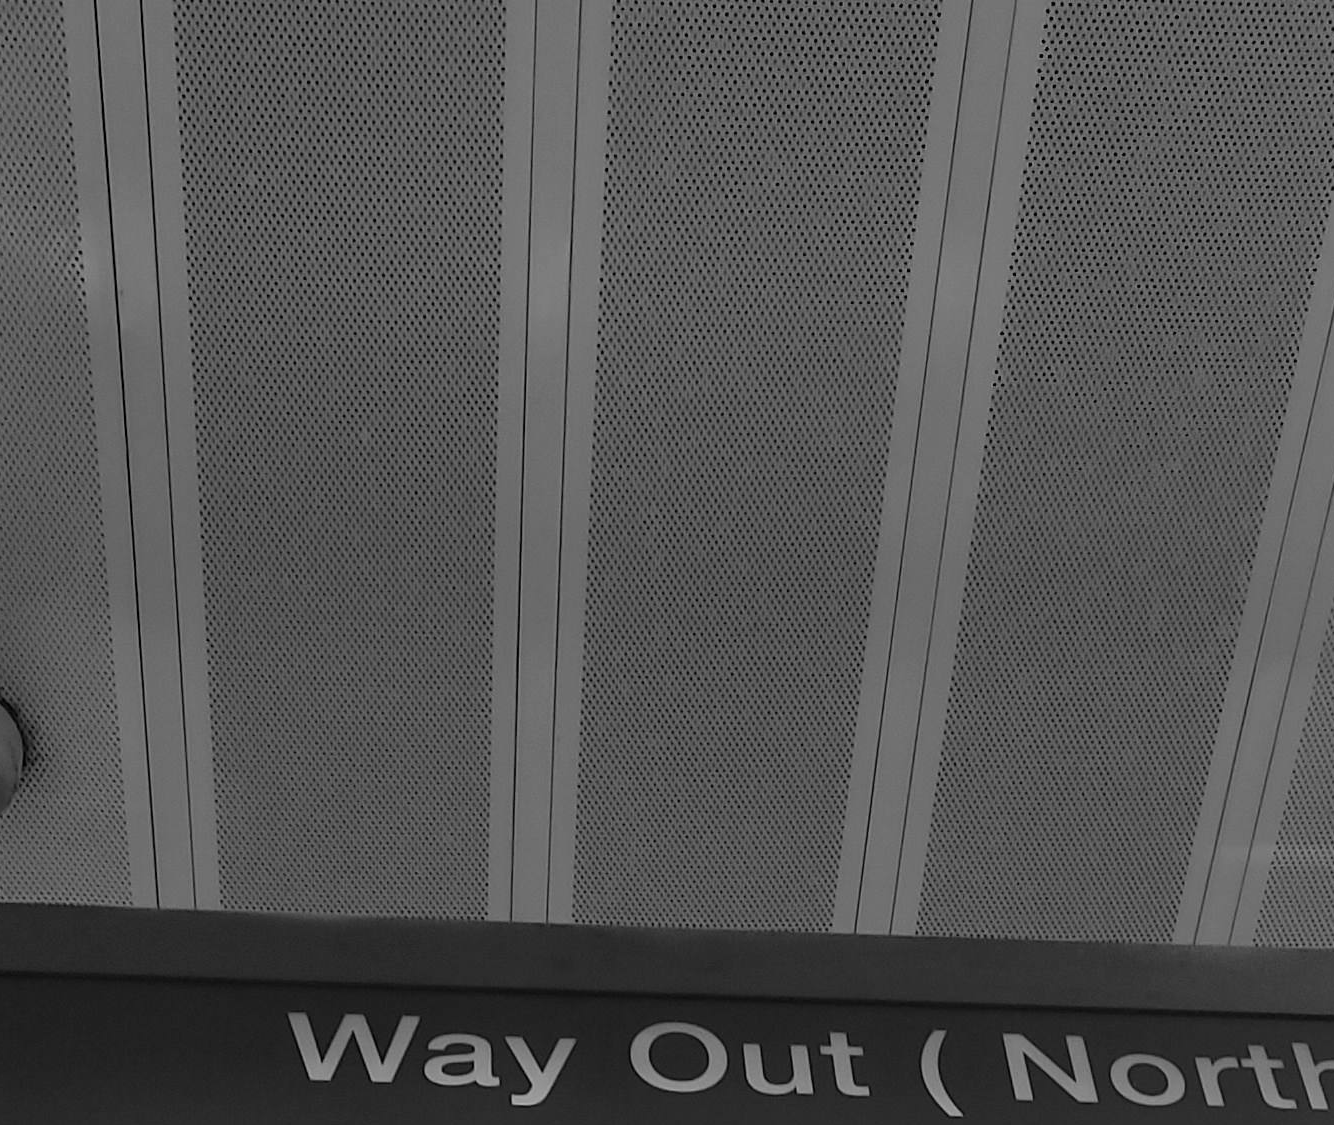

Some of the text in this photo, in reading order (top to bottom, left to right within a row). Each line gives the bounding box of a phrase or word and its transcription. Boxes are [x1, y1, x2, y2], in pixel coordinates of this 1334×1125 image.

[287, 1011, 577, 1107] Way
[629, 1021, 871, 1097] Out
[920, 1029, 964, 1117] (
